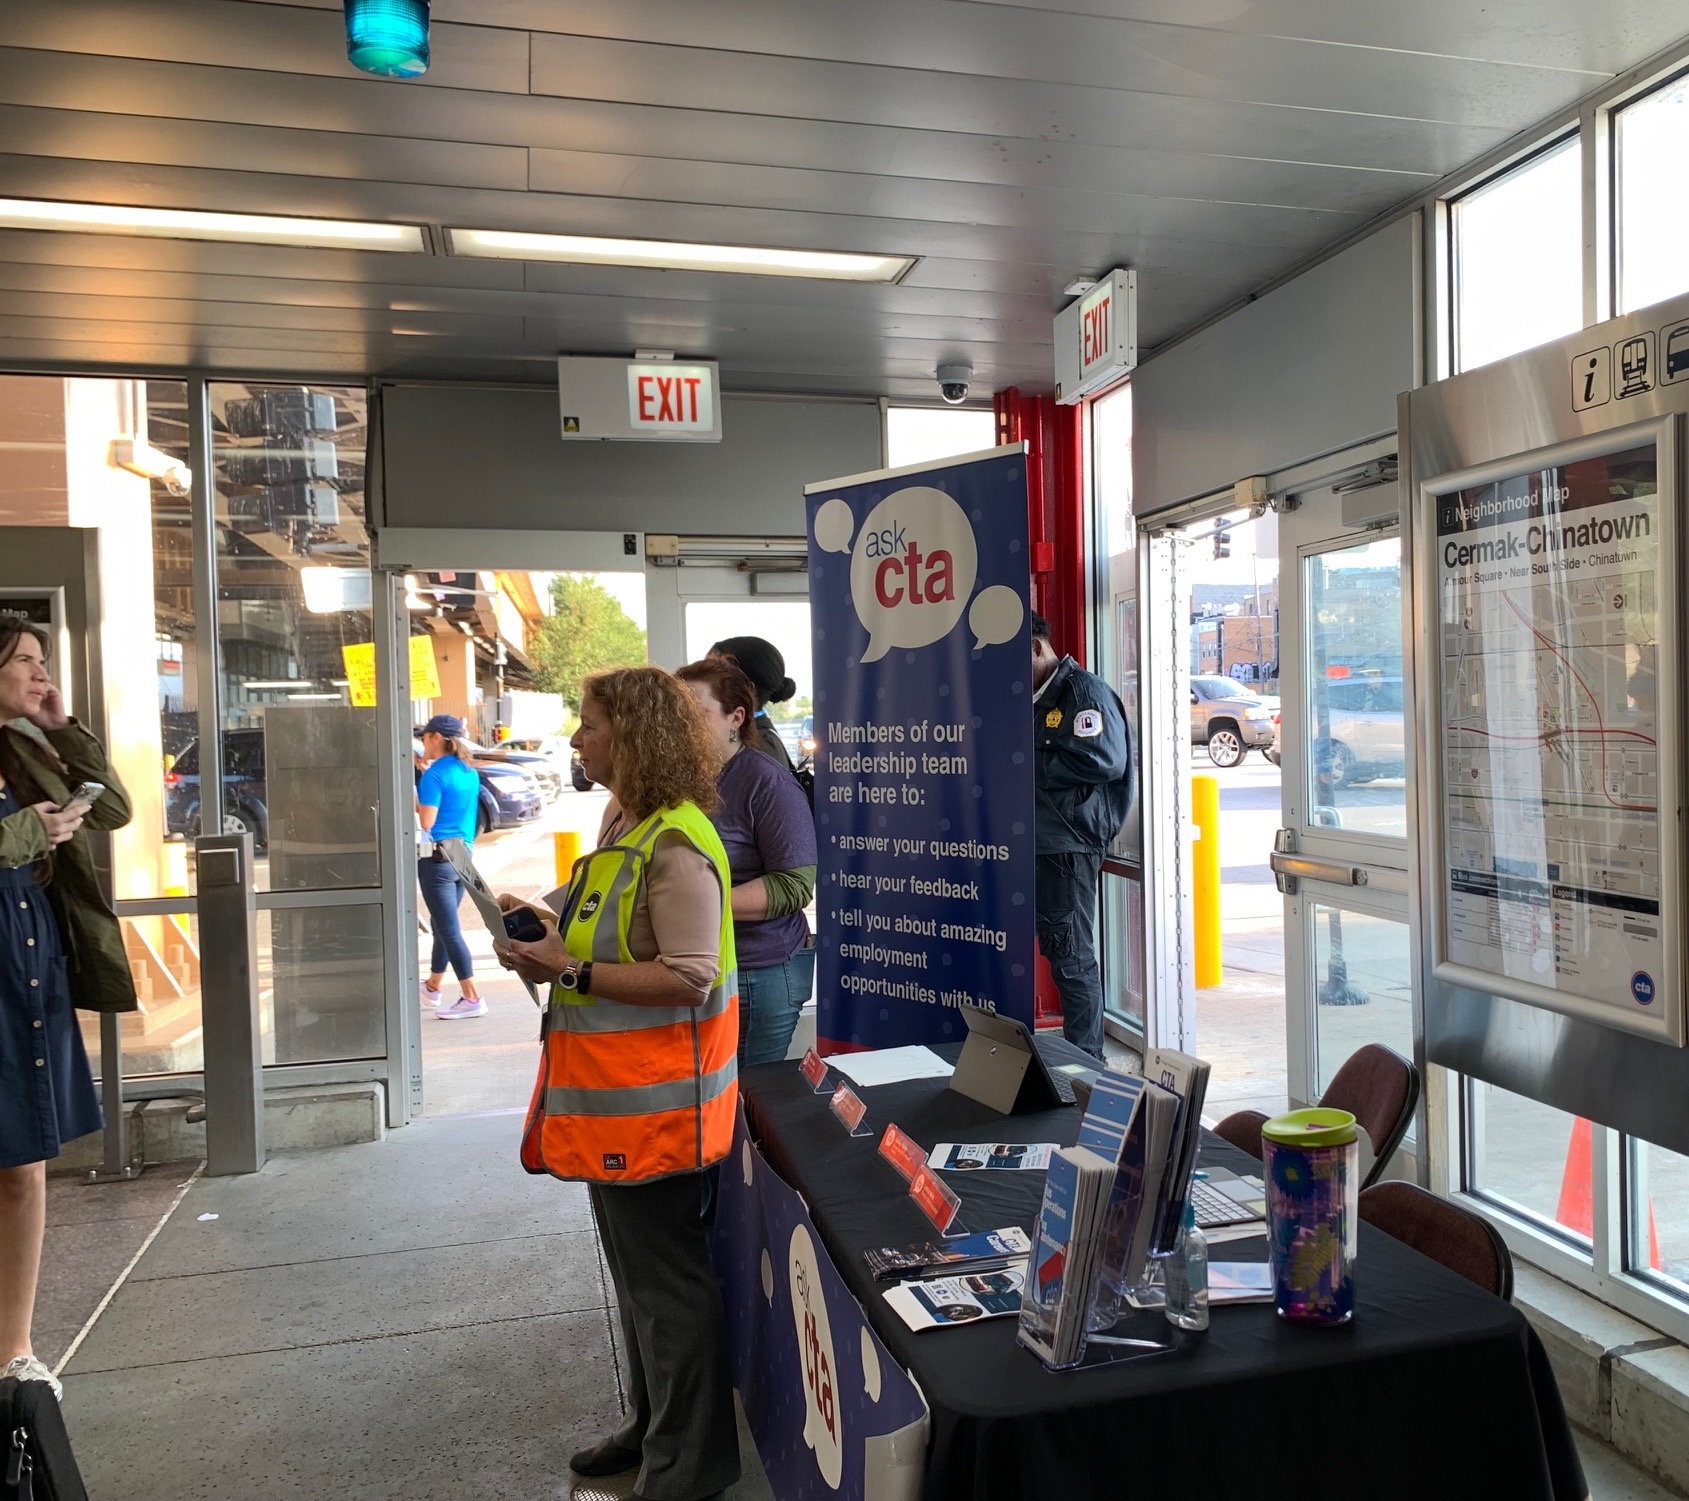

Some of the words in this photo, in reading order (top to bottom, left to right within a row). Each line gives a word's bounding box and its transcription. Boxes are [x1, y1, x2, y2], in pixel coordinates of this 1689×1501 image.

[1084, 297, 1110, 367] EXIT
[637, 376, 701, 423] EXIT
[1455, 489, 1538, 522] Neighborhood
[1543, 485, 1570, 505] Map
[866, 519, 907, 558] ask
[1444, 512, 1650, 568] Cermak-Chinatown
[875, 541, 955, 608] cta
[1474, 570, 1502, 585] Square
[1510, 566, 1530, 578] Near
[1560, 558, 1580, 571] Side
[1588, 551, 1637, 567] Chinatown
[828, 721, 905, 743] Members
[910, 720, 928, 743] of
[933, 724, 966, 743] our
[829, 751, 917, 779] leadership
[922, 752, 968, 774] team
[829, 785, 852, 803] are
[858, 782, 897, 804] here
[902, 784, 925, 805] to:
[839, 835, 889, 851] answer
[893, 838, 925, 857] your
[930, 839, 1009, 861] questions
[839, 870, 871, 889] hear
[875, 875, 906, 894] your
[910, 875, 979, 900] feedback
[1553, 888, 1576, 899] Legend
[582, 898, 598, 913] cta
[839, 908, 862, 927] tell
[866, 913, 891, 932] you
[895, 915, 936, 937] about
[941, 924, 1007, 951] amazing
[840, 943, 928, 969] employment
[841, 975, 936, 1005] opportunities
[940, 989, 973, 1008] with
[978, 999, 996, 1013] us
[1634, 982, 1651, 994] cta
[1161, 1070, 1175, 1091] CTA
[619, 1156, 623, 1164] 1
[1004, 1238, 1021, 1249] CTA
[805, 1310, 837, 1447] cta
